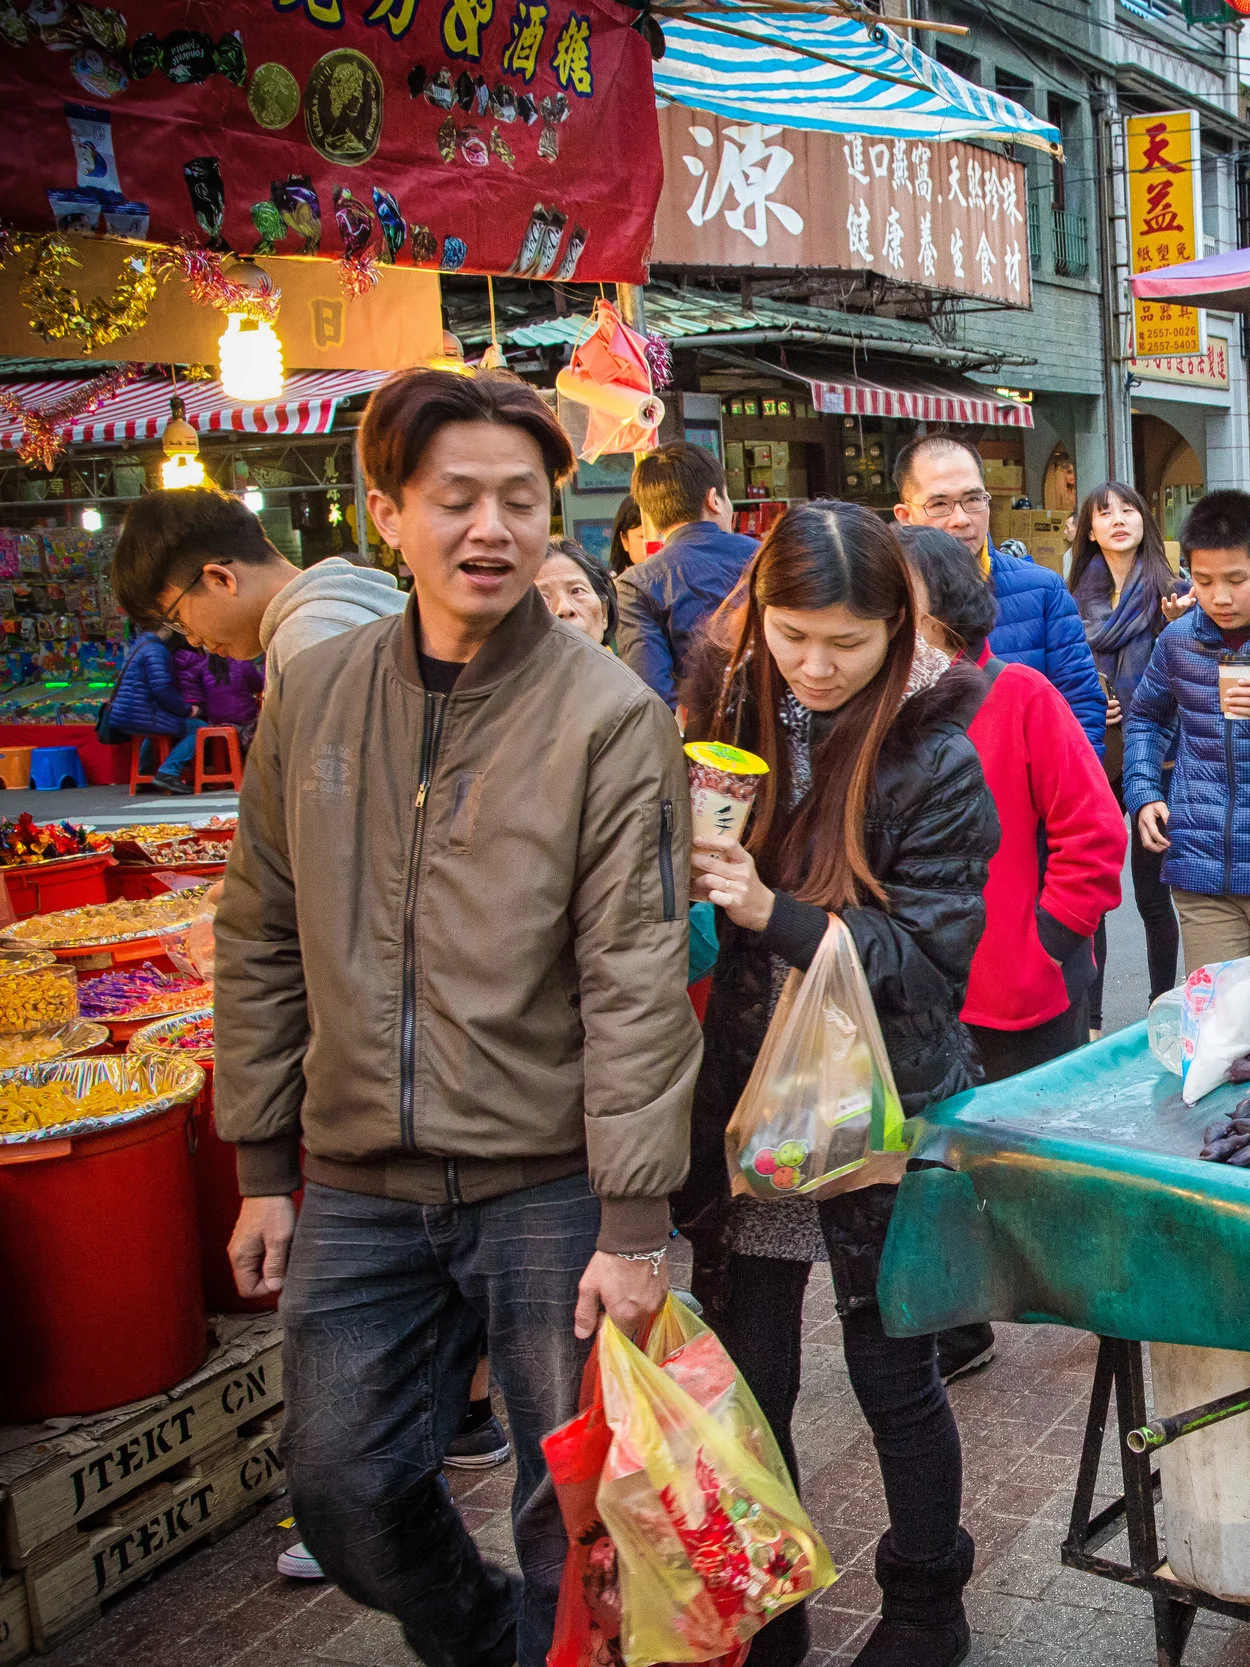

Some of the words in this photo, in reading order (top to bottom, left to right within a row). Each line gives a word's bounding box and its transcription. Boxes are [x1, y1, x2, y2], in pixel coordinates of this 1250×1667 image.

[682, 123, 804, 247] 源
[1139, 122, 1186, 237] 天益
[847, 198, 1022, 292] 健康養生食材
[1147, 327, 1196, 339] 2557-0026
[1148, 340, 1197, 352] 2557-5403
[70, 1405, 196, 1516] JTEKT
[221, 1365, 267, 1415] CN
[92, 1483, 215, 1597] JTEKT
